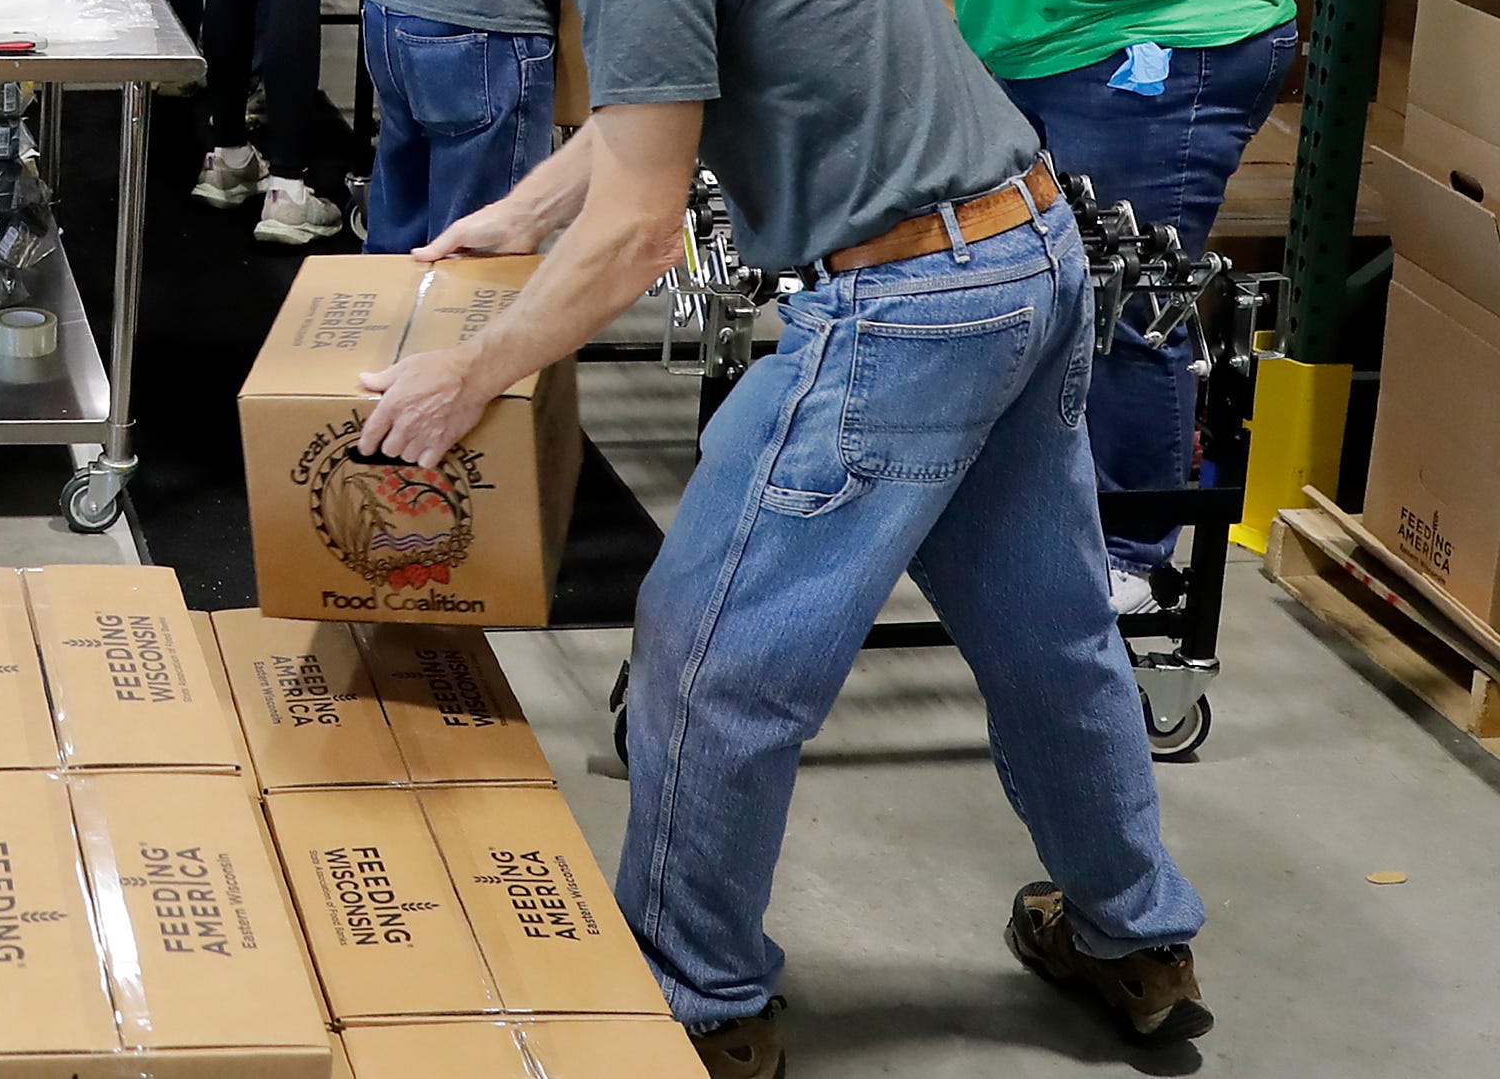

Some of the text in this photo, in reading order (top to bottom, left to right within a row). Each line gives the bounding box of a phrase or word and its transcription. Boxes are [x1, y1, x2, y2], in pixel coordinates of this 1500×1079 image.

[311, 292, 353, 350] AMERICA
[336, 292, 378, 350] FEEDING
[457, 289, 497, 345] EEDING
[291, 408, 496, 489] Great Lak ribal
[1398, 524, 1450, 575] AMERICA
[1401, 507, 1454, 557] FEEDING
[321, 586, 486, 614] Food Coalition
[96, 614, 146, 702] FEEDING
[127, 615, 176, 703] WISCONSIN
[253, 661, 282, 725] Eastern Wisconsin
[270, 655, 315, 728] AMERICA
[297, 654, 340, 726] FEEDING
[416, 649, 469, 728] FEEDING
[446, 649, 495, 728] WISCONSIN
[141, 846, 195, 954] FEEDING
[175, 846, 232, 957] AMERICA
[222, 852, 258, 950] Eastern Wisconsin
[324, 847, 380, 946] WISCONSIN
[352, 845, 412, 944] FEEDING
[490, 849, 551, 940] FEEDING
[520, 849, 581, 941] AMERICA
[553, 854, 600, 936] Eastern Wisconsin
